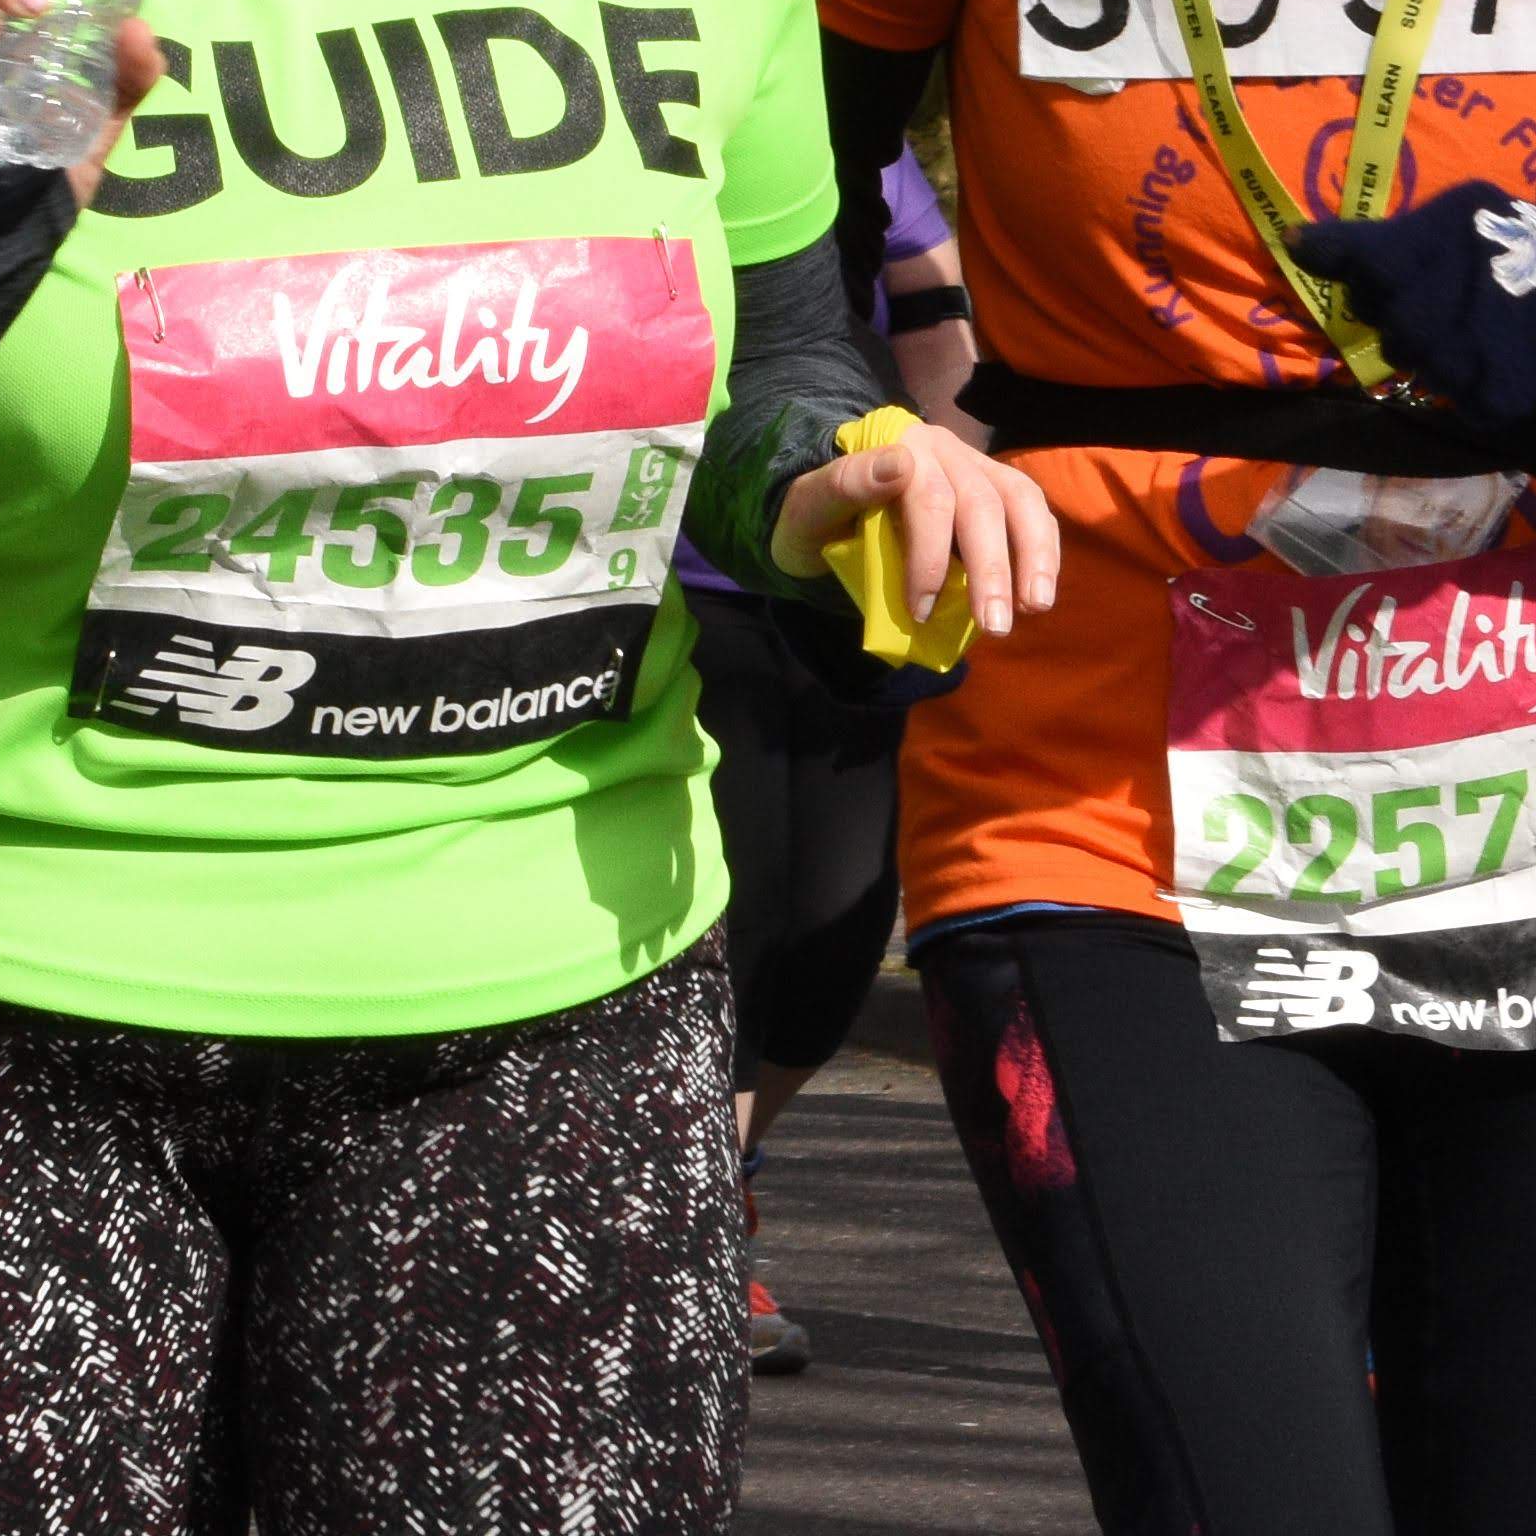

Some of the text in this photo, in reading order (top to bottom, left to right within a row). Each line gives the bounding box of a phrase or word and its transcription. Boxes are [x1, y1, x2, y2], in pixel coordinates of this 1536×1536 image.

[94, 0, 707, 219] GUIDE
[1202, 73, 1232, 136] LEARN
[1240, 167, 1287, 233] SUSTAI
[1356, 162, 1379, 220] ISTEN
[1374, 63, 1402, 128] LEARN
[272, 266, 589, 425] Vitality
[131, 469, 596, 590] 24535
[608, 548, 638, 592] 9
[311, 701, 421, 737] new
[430, 667, 624, 735] balance
[1391, 996, 1493, 1031] new
